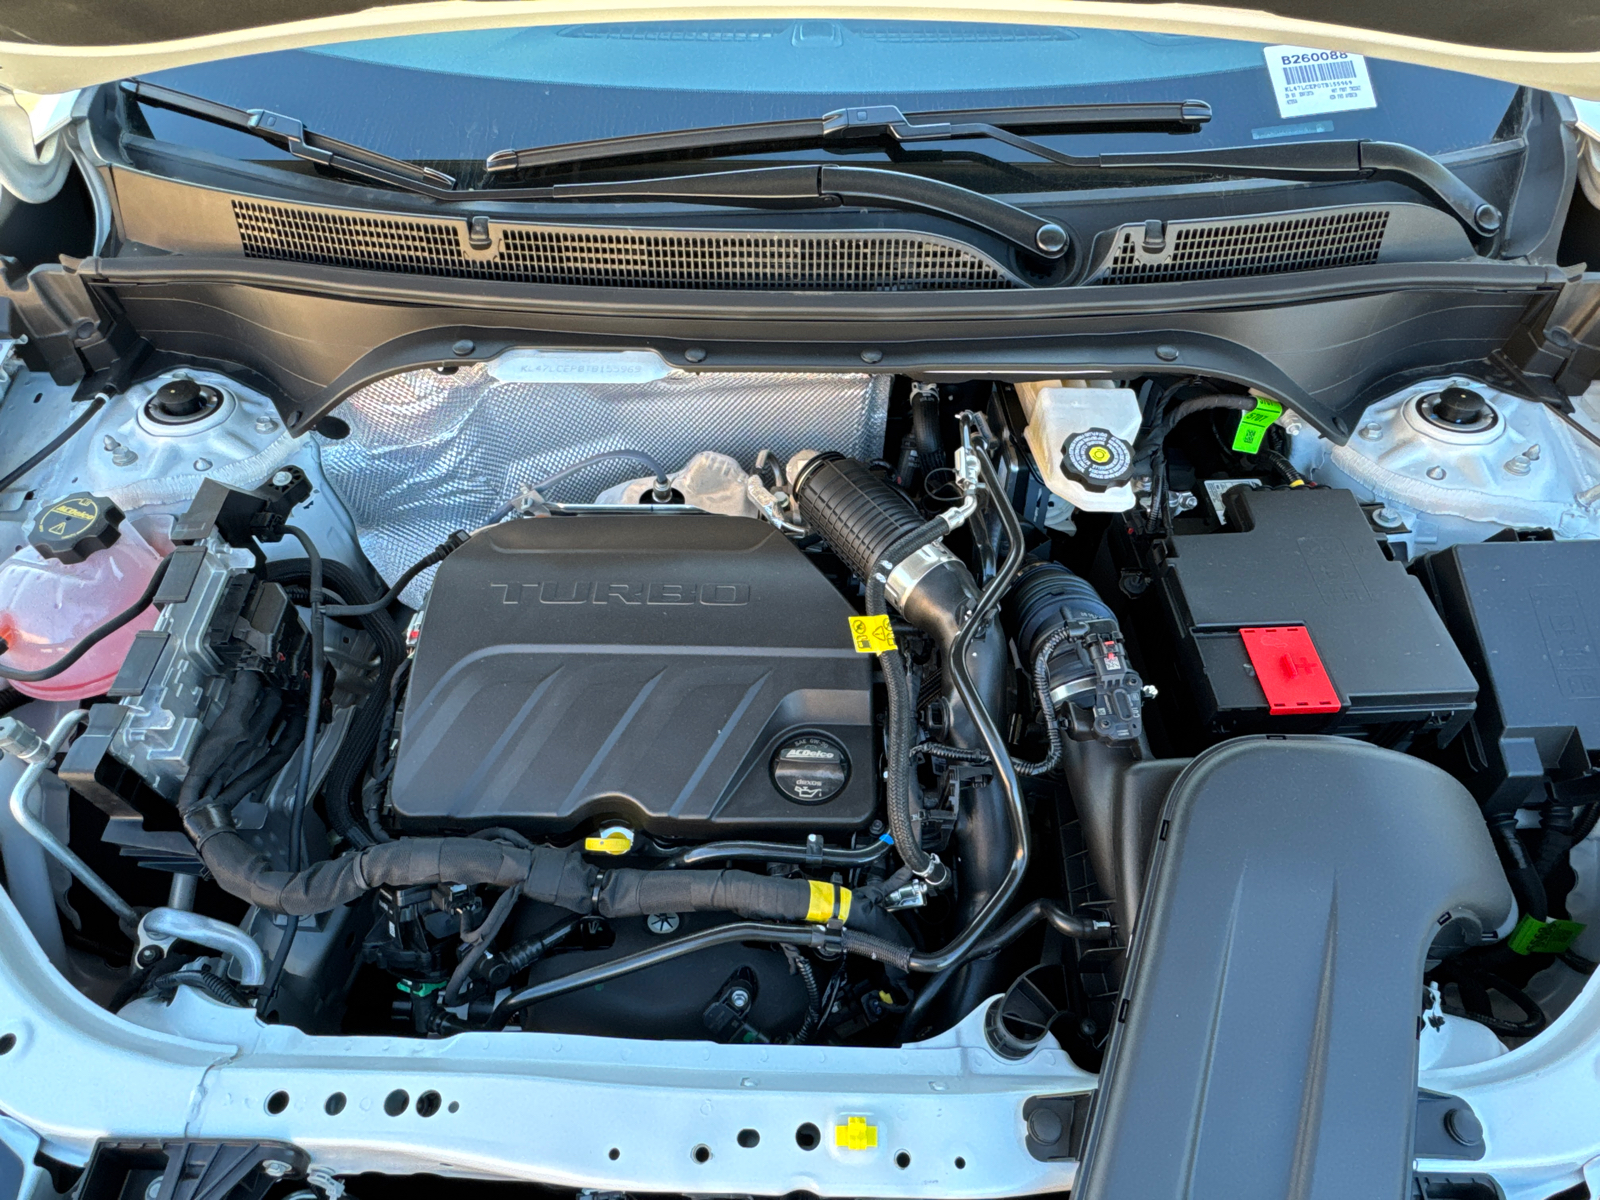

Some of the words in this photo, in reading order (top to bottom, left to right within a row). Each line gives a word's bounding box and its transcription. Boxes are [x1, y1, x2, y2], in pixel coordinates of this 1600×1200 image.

[1281, 50, 1348, 65] B260088
[56, 505, 95, 519] ACDelco
[490, 581, 750, 605] TURBO
[794, 739, 807, 747] SAE
[786, 749, 834, 758] ACDelco
